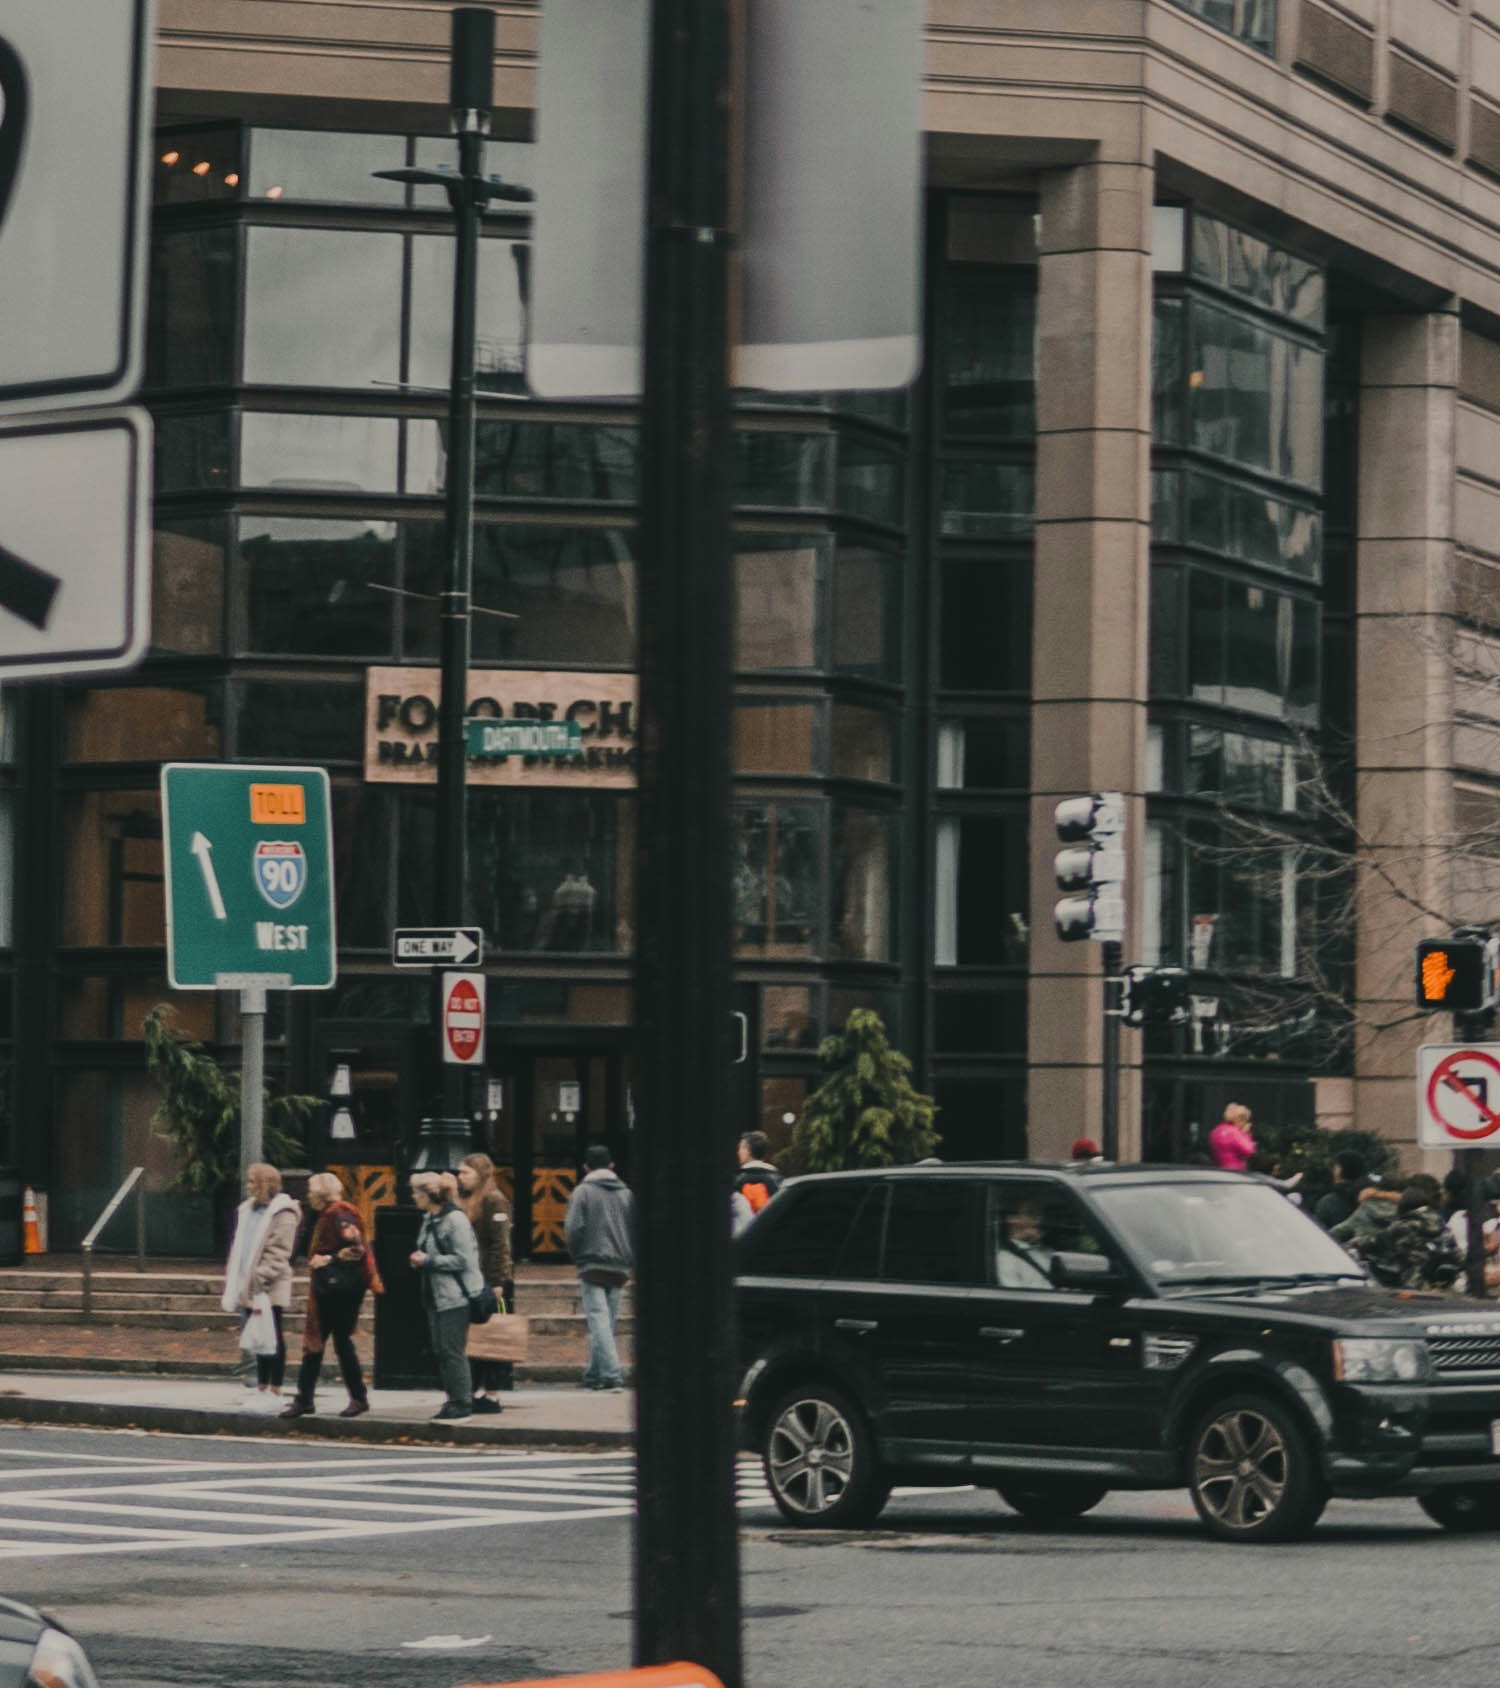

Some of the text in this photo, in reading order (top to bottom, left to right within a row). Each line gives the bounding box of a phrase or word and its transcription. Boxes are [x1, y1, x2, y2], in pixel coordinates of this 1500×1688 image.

[483, 726, 568, 751] DARTMOUTH
[256, 791, 299, 815] TOLL
[262, 861, 298, 892] 90
[256, 921, 308, 950] WEST
[403, 940, 453, 953] ONE WAY
[451, 998, 479, 1010] DO NOT
